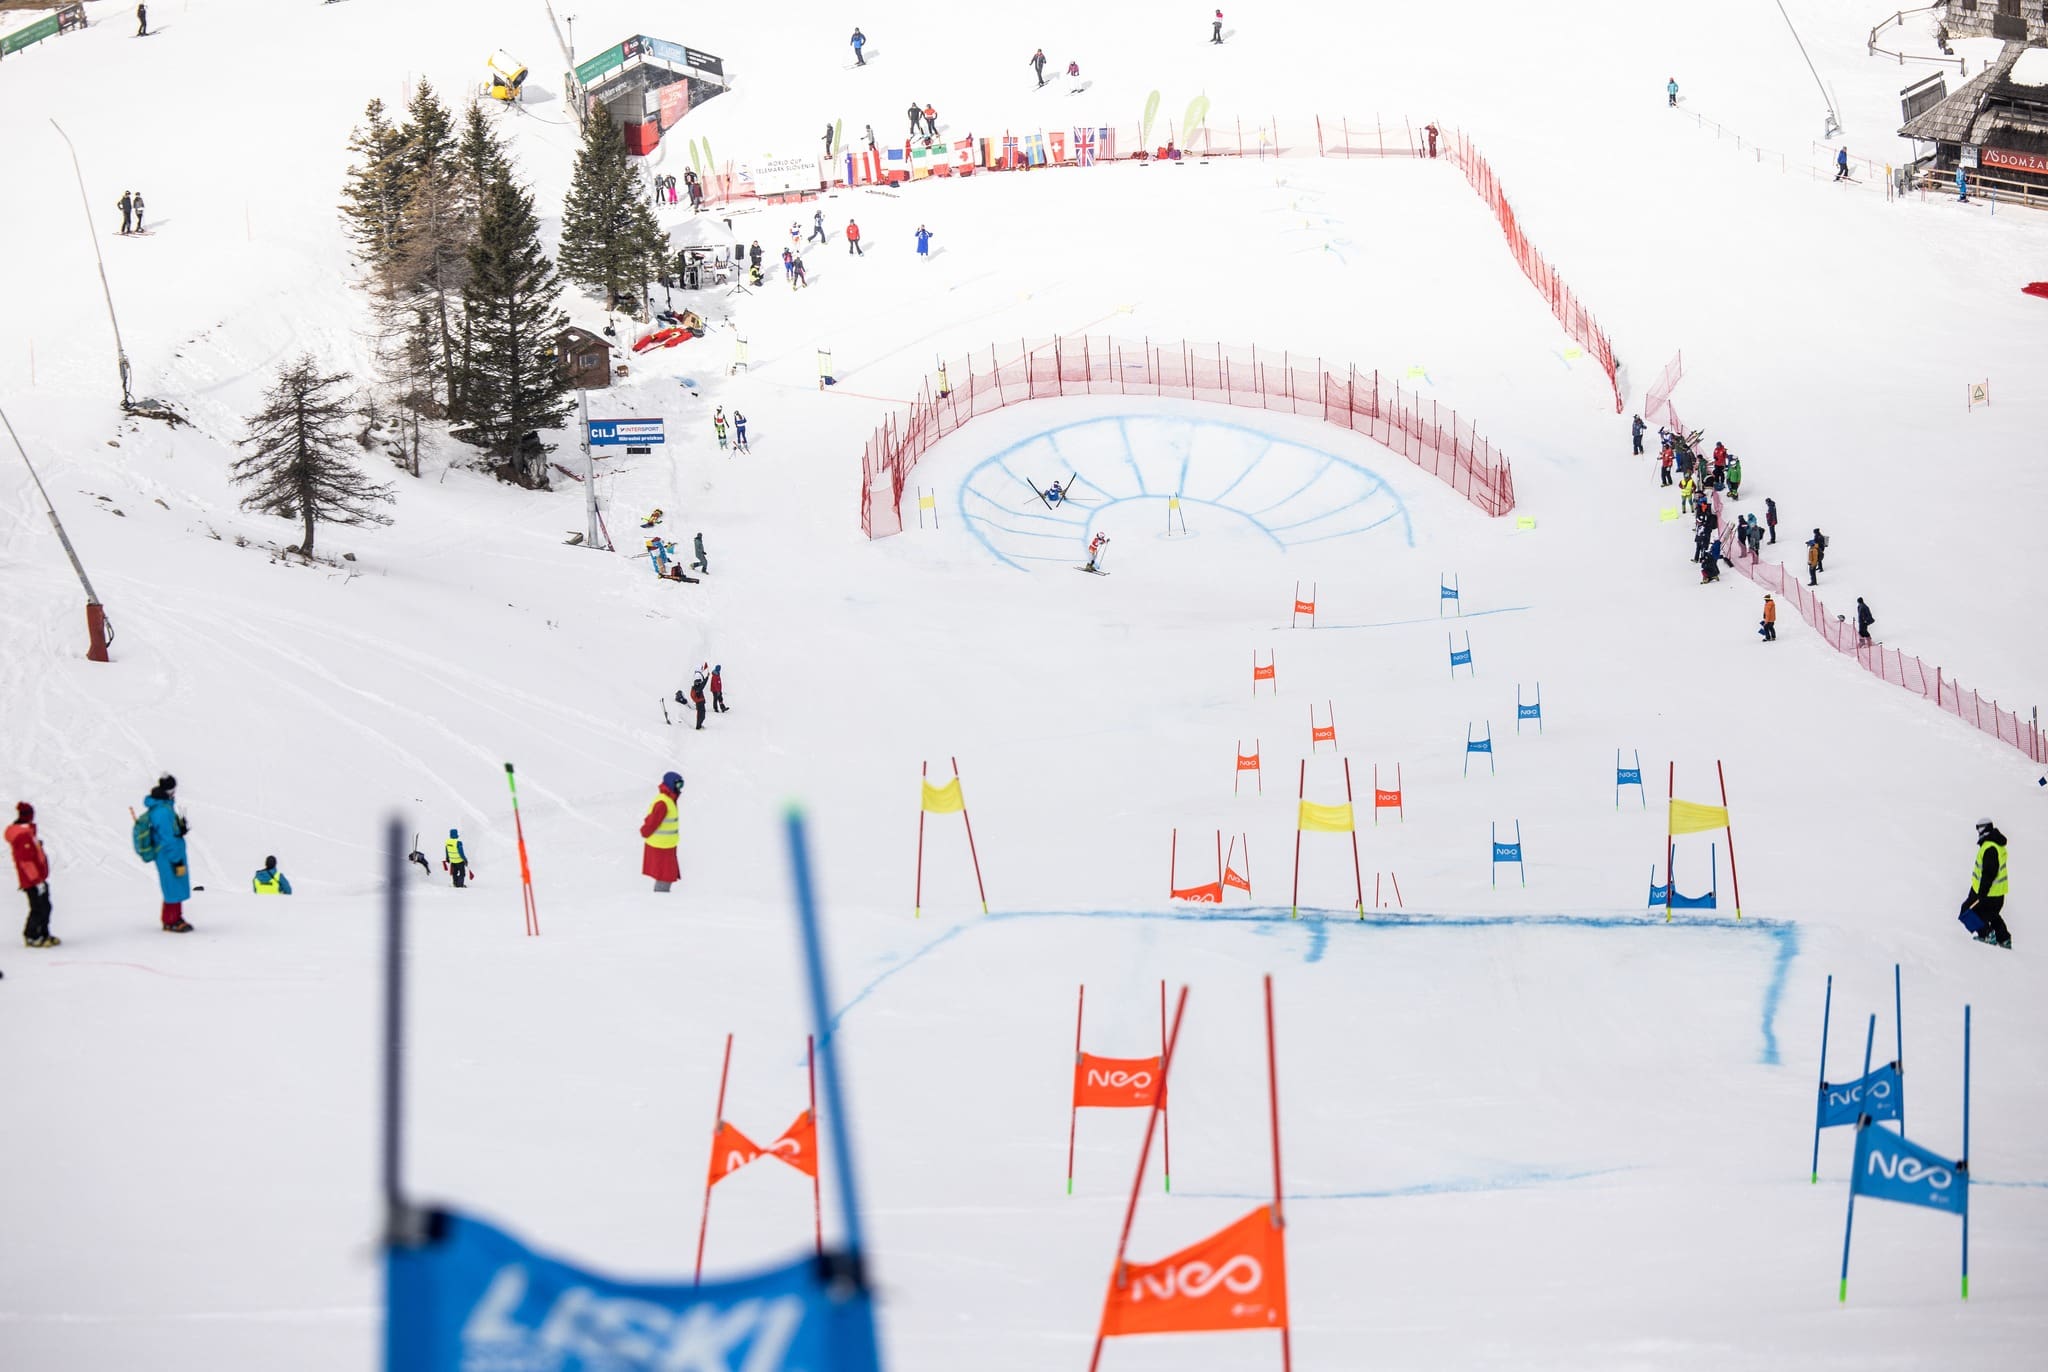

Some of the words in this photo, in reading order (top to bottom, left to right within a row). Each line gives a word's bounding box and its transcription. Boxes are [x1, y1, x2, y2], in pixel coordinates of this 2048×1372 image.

[755, 166, 785, 174] TELEMARK
[786, 163, 815, 171] SLOVENIA
[591, 428, 616, 438] CILJ
